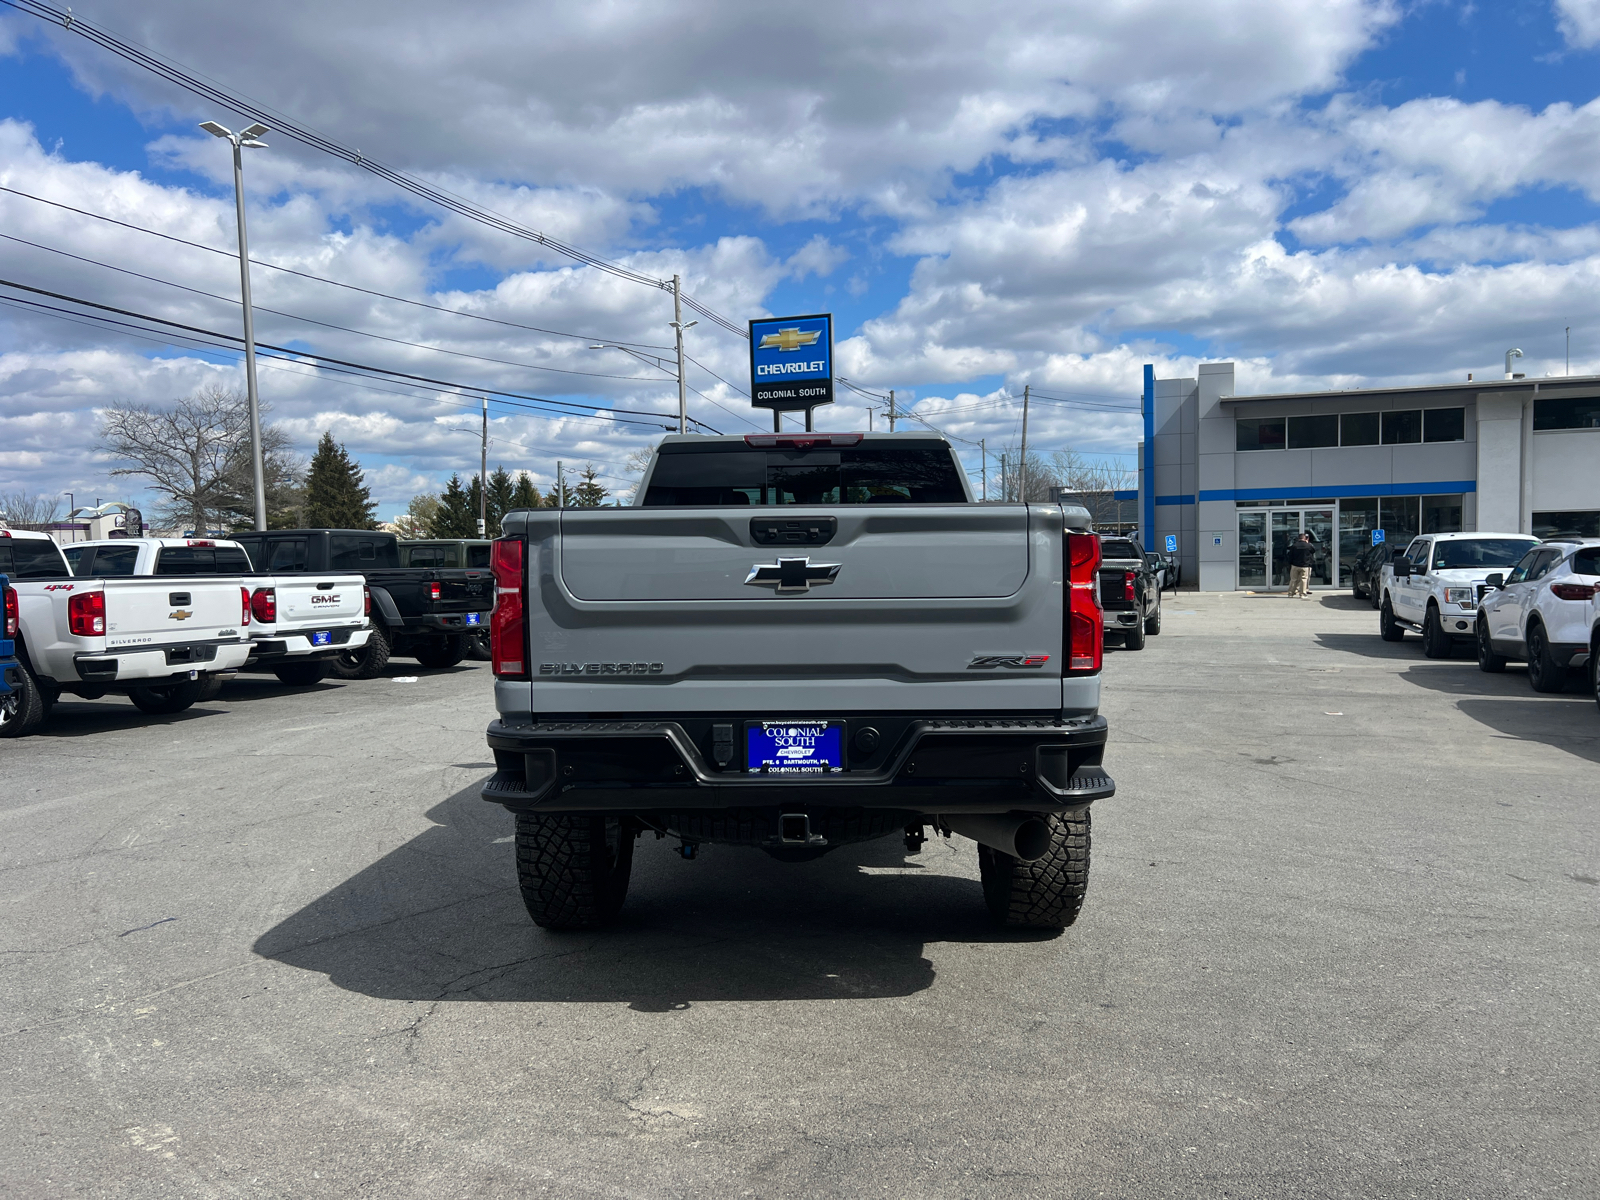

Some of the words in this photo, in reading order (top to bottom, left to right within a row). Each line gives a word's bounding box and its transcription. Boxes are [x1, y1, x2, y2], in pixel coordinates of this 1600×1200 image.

[757, 360, 825, 376] CHEVROLET
[757, 389, 797, 400] COLONIAL
[799, 387, 826, 397] SOUTH
[465, 581, 482, 593] Jeep
[311, 594, 341, 604] GMC
[111, 637, 152, 645] SILVERADO
[966, 654, 1051, 669] ZR2
[539, 662, 664, 675] SILVERADO
[766, 727, 825, 738] COLONIAL
[775, 737, 815, 747] SOUTH
